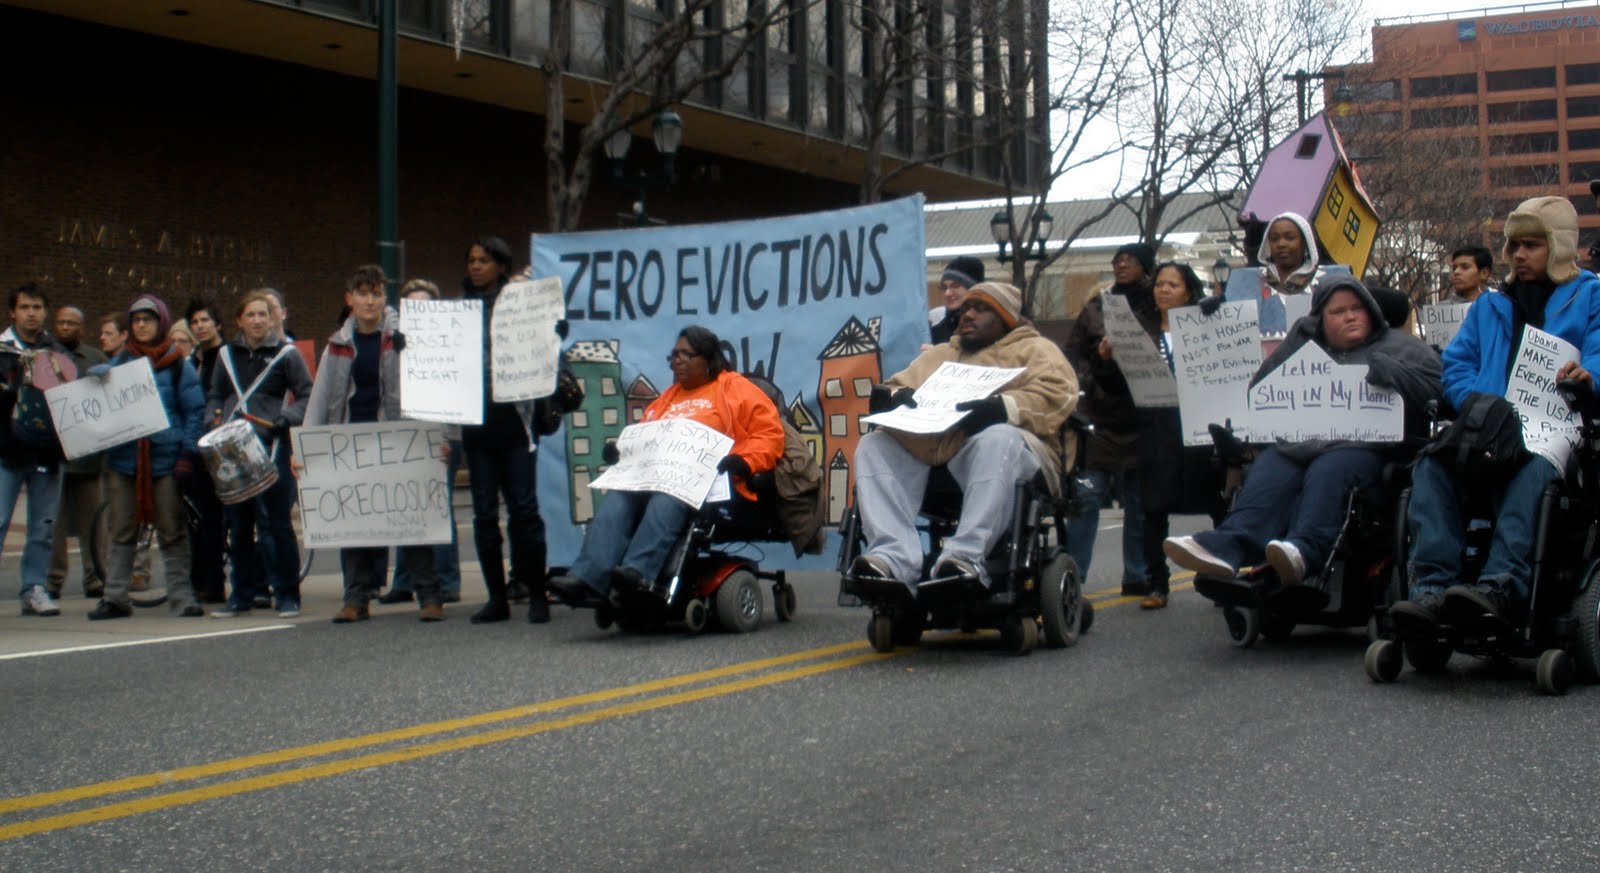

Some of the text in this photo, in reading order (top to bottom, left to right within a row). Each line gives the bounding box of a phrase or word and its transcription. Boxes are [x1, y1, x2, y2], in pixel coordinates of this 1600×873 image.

[1485, 15, 1598, 35] WACHOVIA
[560, 223, 888, 321] ZERO EVICTIONS
[1176, 304, 1243, 330] MONEY
[405, 332, 463, 350] BASIC
[1182, 347, 1210, 364] NOT
[1311, 361, 1332, 376] ME
[1523, 348, 1555, 371] MAKE
[1185, 361, 1219, 378] STOP
[50, 396, 102, 434] ZERO
[1516, 388, 1539, 409] THE
[1546, 400, 1575, 425] USA
[680, 421, 723, 449] STAY
[298, 428, 443, 476] FREEZE
[667, 440, 716, 469] HOME
